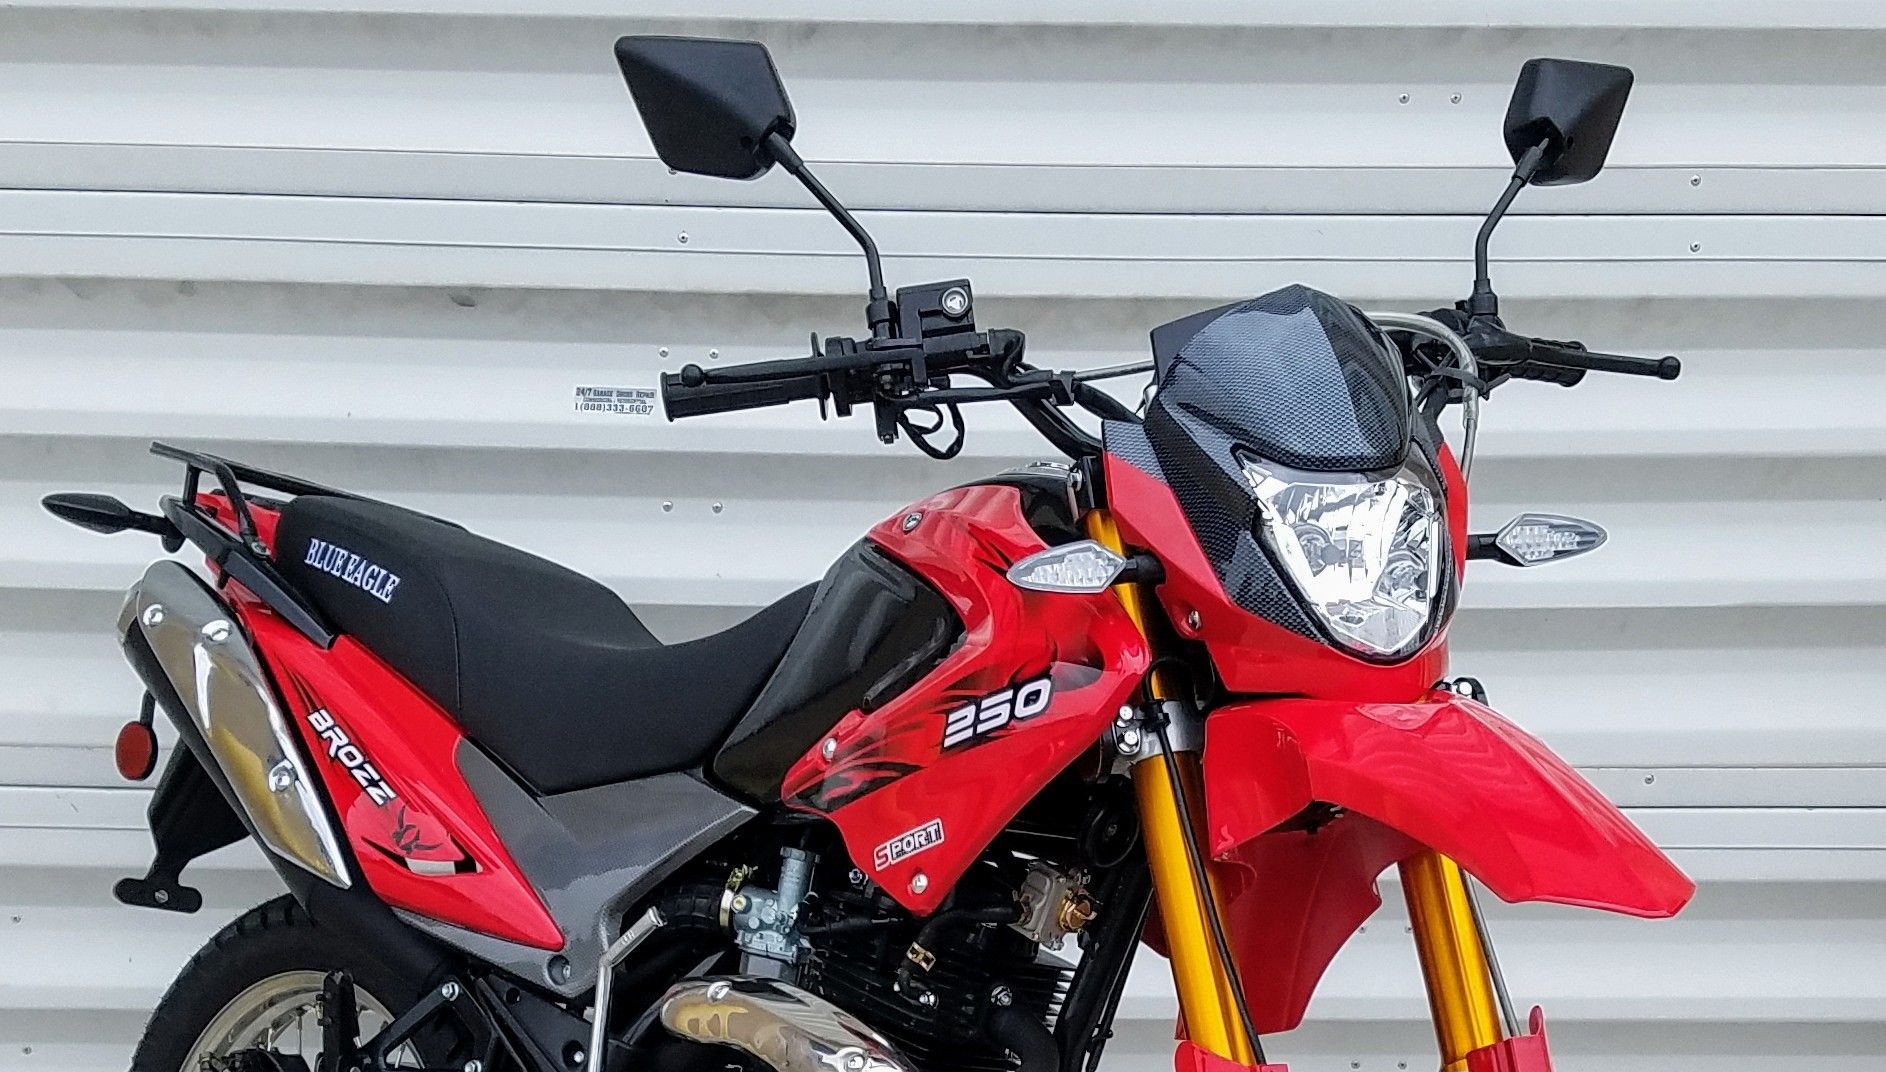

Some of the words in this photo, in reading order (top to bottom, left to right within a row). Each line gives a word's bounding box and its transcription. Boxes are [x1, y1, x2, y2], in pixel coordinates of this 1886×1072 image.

[575, 387, 592, 397] 24/7
[304, 538, 348, 578] BLUE
[341, 554, 400, 604] EAGLE
[943, 678, 1052, 748] 250
[307, 709, 397, 806] BROZZ
[875, 821, 943, 868] SPORT
